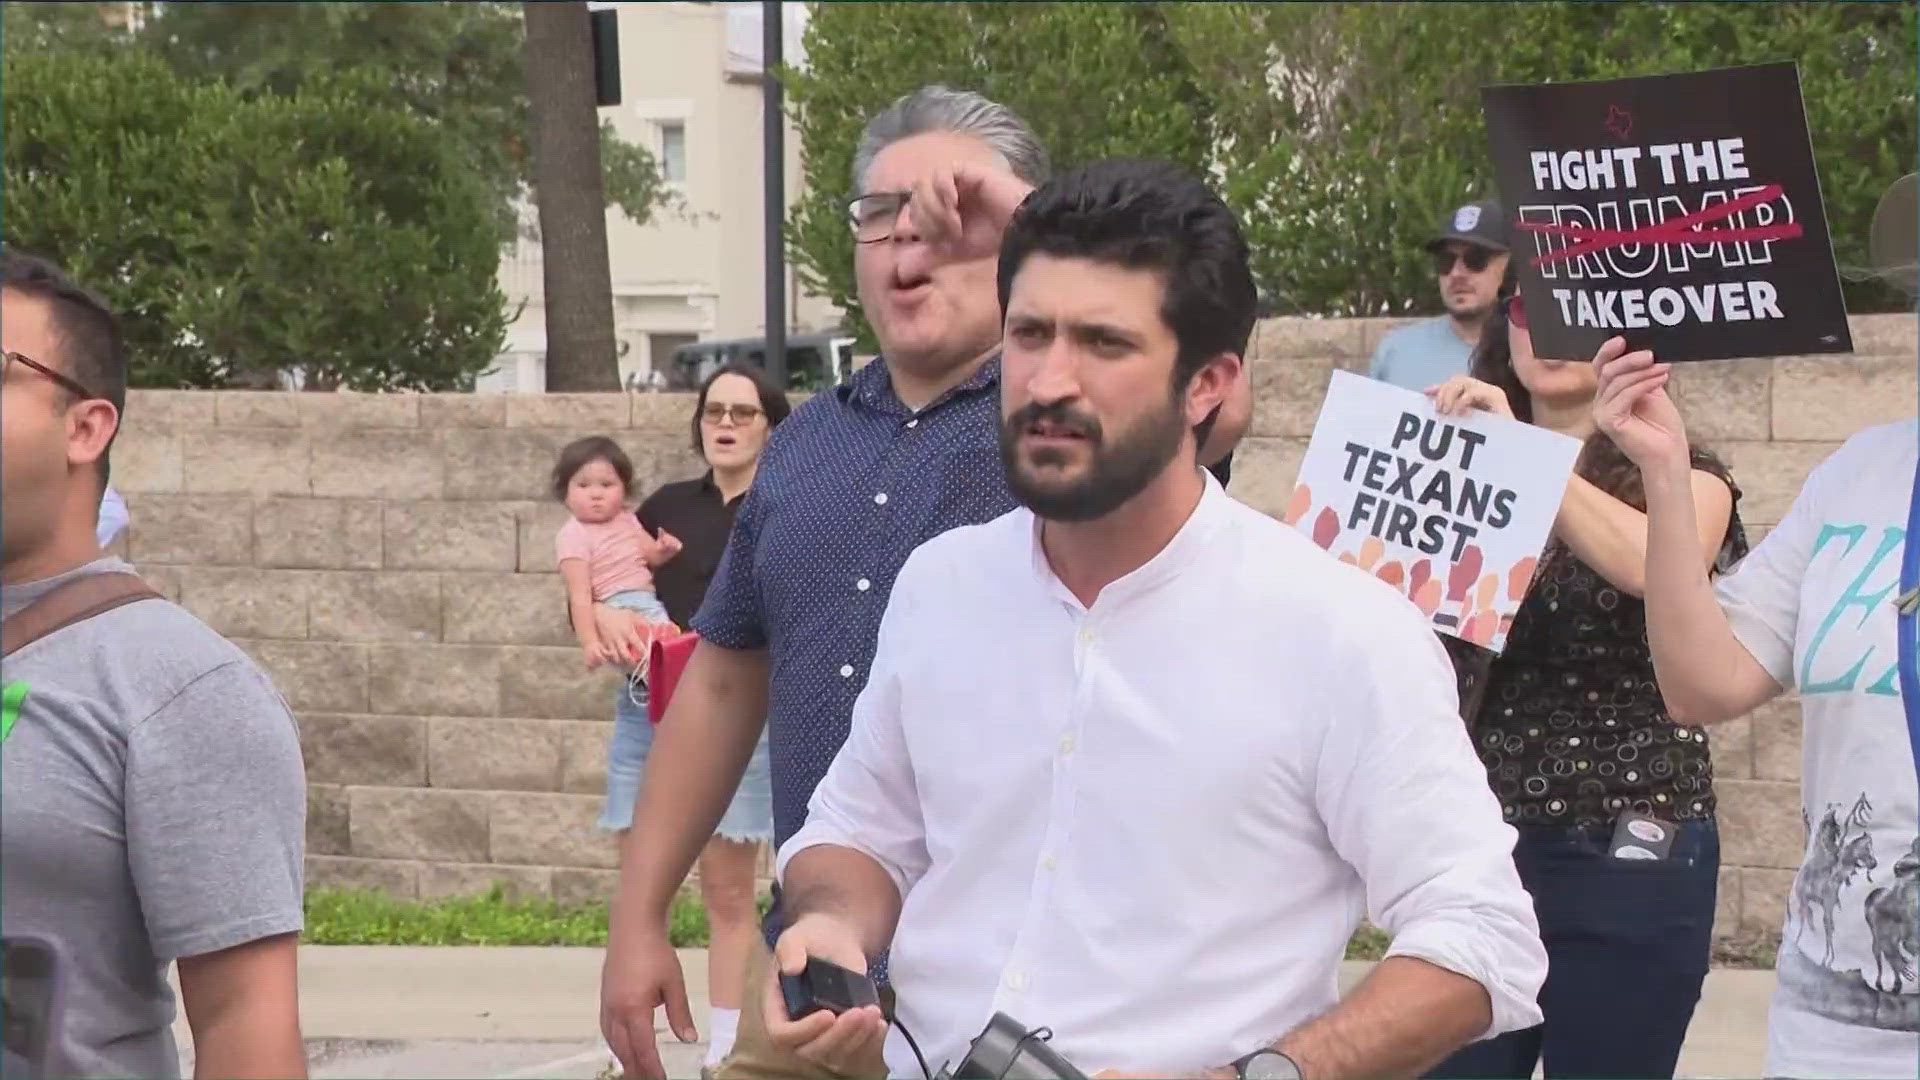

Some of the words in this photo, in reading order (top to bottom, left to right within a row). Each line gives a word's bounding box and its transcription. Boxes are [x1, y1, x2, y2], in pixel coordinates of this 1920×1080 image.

[1530, 147, 1641, 190] FIGHT
[1650, 137, 1749, 184] THE
[1519, 185, 1794, 279] TRUMP
[1552, 280, 1784, 329] TAKEOVER
[1391, 411, 1486, 470] PUT
[1343, 441, 1517, 529] TEXANS
[1347, 491, 1478, 562] FIRST
